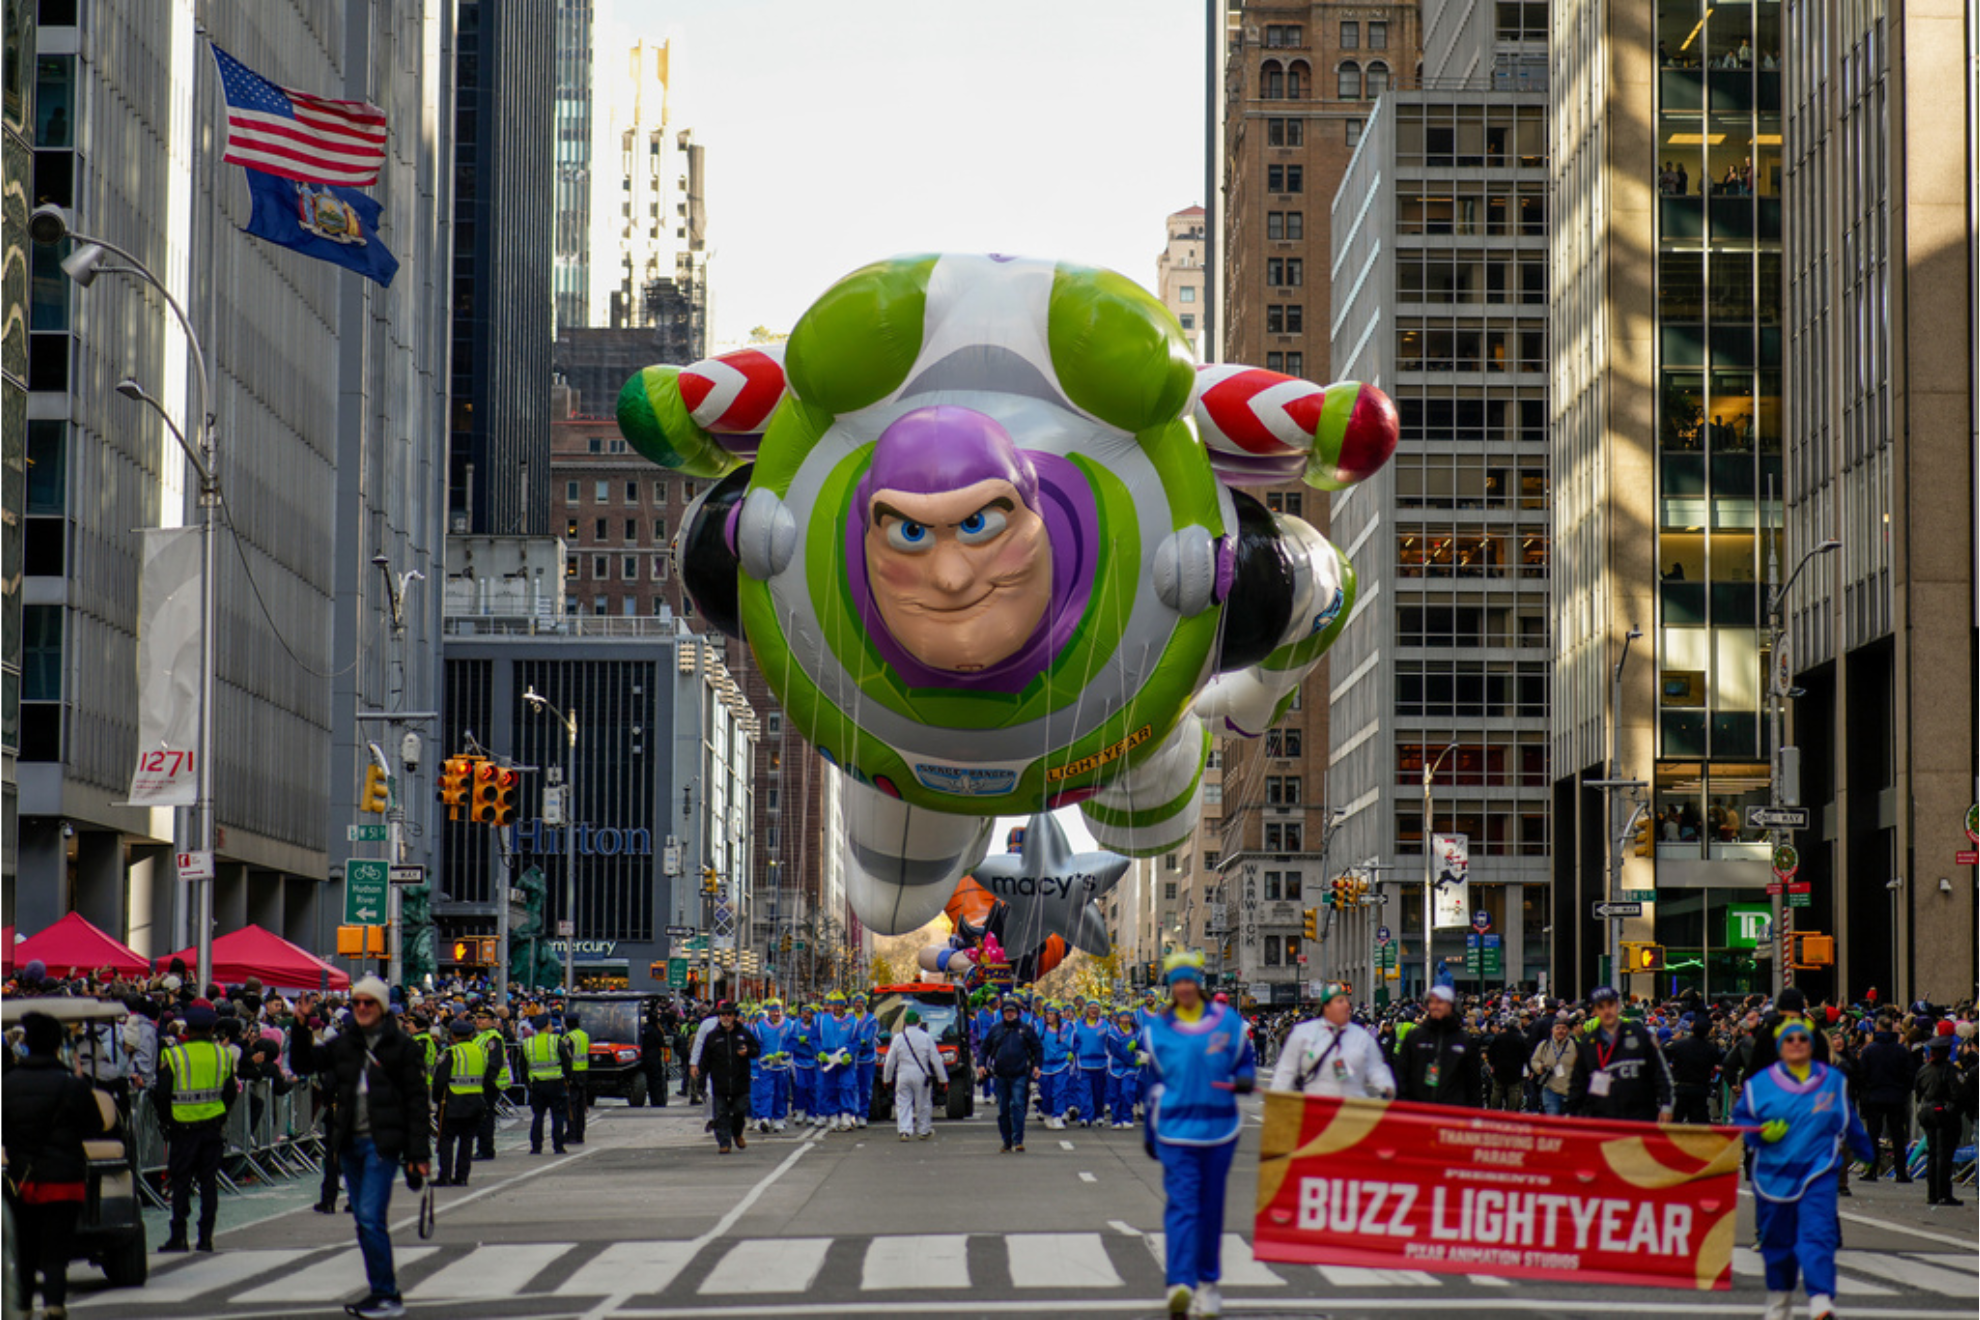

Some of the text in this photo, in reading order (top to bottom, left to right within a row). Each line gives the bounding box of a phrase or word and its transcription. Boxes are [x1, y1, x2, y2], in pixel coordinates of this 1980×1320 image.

[140, 751, 193, 777] 1271
[1048, 728, 1150, 781] LIGHTYEAR
[920, 764, 961, 776] SPACE
[1782, 813, 1799, 822] WAY
[352, 885, 382, 893] Hudson
[356, 895, 377, 904] River
[1245, 865, 1257, 946] WARWICK
[1732, 912, 1773, 939] TD
[1439, 1128, 1563, 1152] THANKSGIVING DAY
[1473, 1148, 1526, 1167] PARADE
[1444, 1168, 1551, 1185] PRESENTS
[1298, 1176, 1692, 1257] BUZZ LIGHTYEAR
[1405, 1243, 1580, 1271] PIXAR ANIMATION STUDIOS
